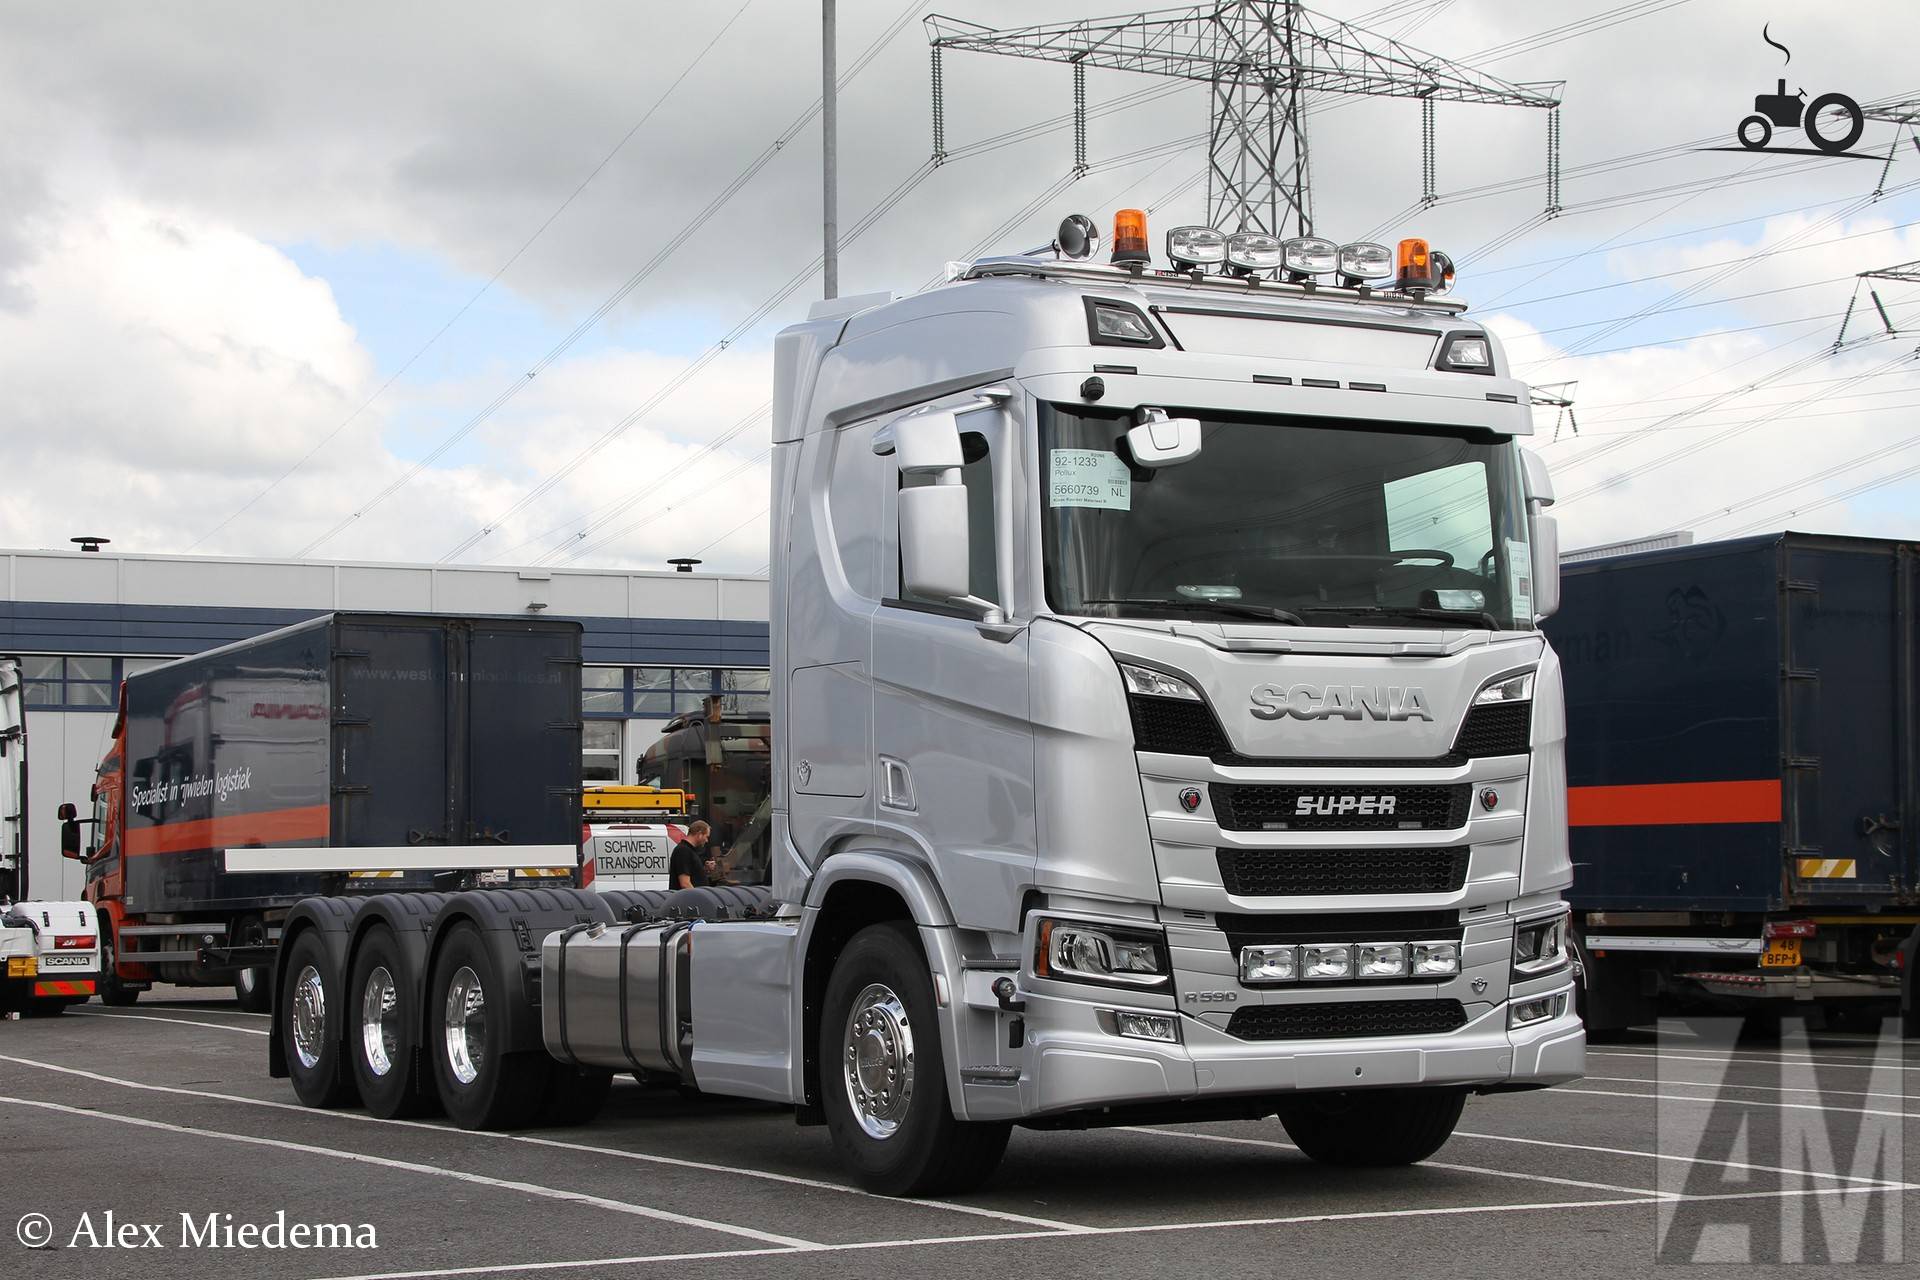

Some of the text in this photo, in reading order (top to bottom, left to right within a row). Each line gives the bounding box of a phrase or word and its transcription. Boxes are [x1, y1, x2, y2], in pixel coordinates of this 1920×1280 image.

[1054, 456, 1098, 467] 92-1233
[1054, 484, 1100, 496] 5660739
[1111, 487, 1126, 497] NL
[1249, 682, 1434, 722] SCANIA
[131, 782, 168, 813] Specialist
[169, 779, 178, 801] in
[214, 766, 252, 802] logistiek
[1295, 795, 1397, 815] SUPER
[604, 840, 656, 854] SCHWER-
[598, 856, 666, 869] TRANSPORT
[46, 957, 89, 966] SCANIA
